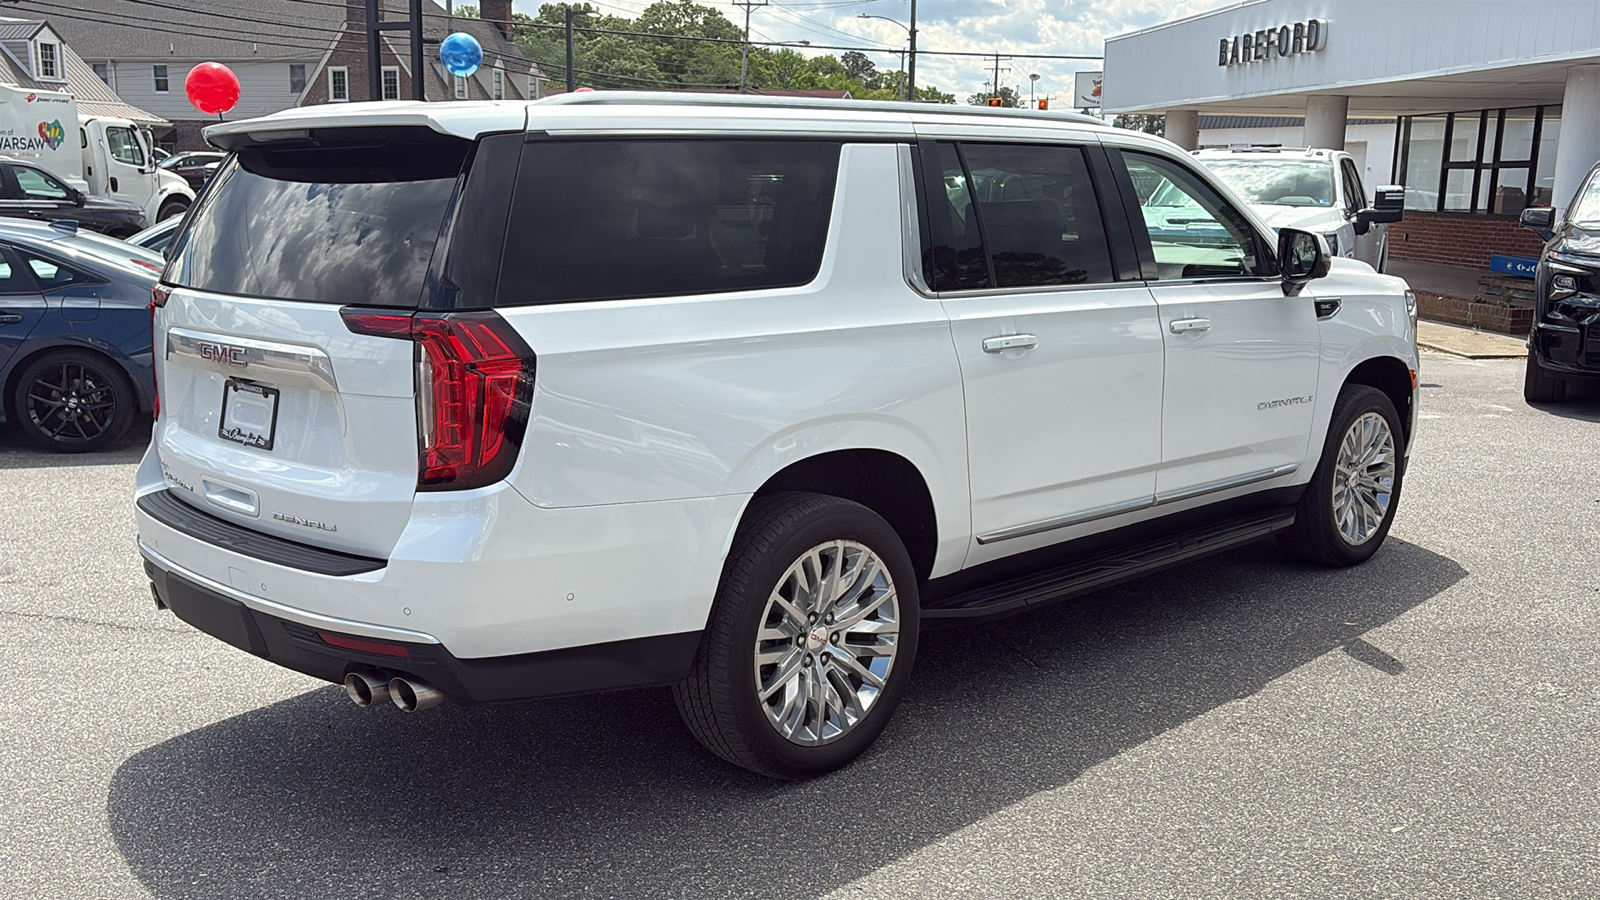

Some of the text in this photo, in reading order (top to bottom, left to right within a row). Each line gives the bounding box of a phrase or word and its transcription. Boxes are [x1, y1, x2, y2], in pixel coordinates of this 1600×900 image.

[1218, 18, 1323, 67] BAREFORD
[199, 342, 248, 367] GMC
[1257, 395, 1313, 411] DENALI
[271, 511, 338, 532] DENALI
[810, 633, 828, 646] GMC
